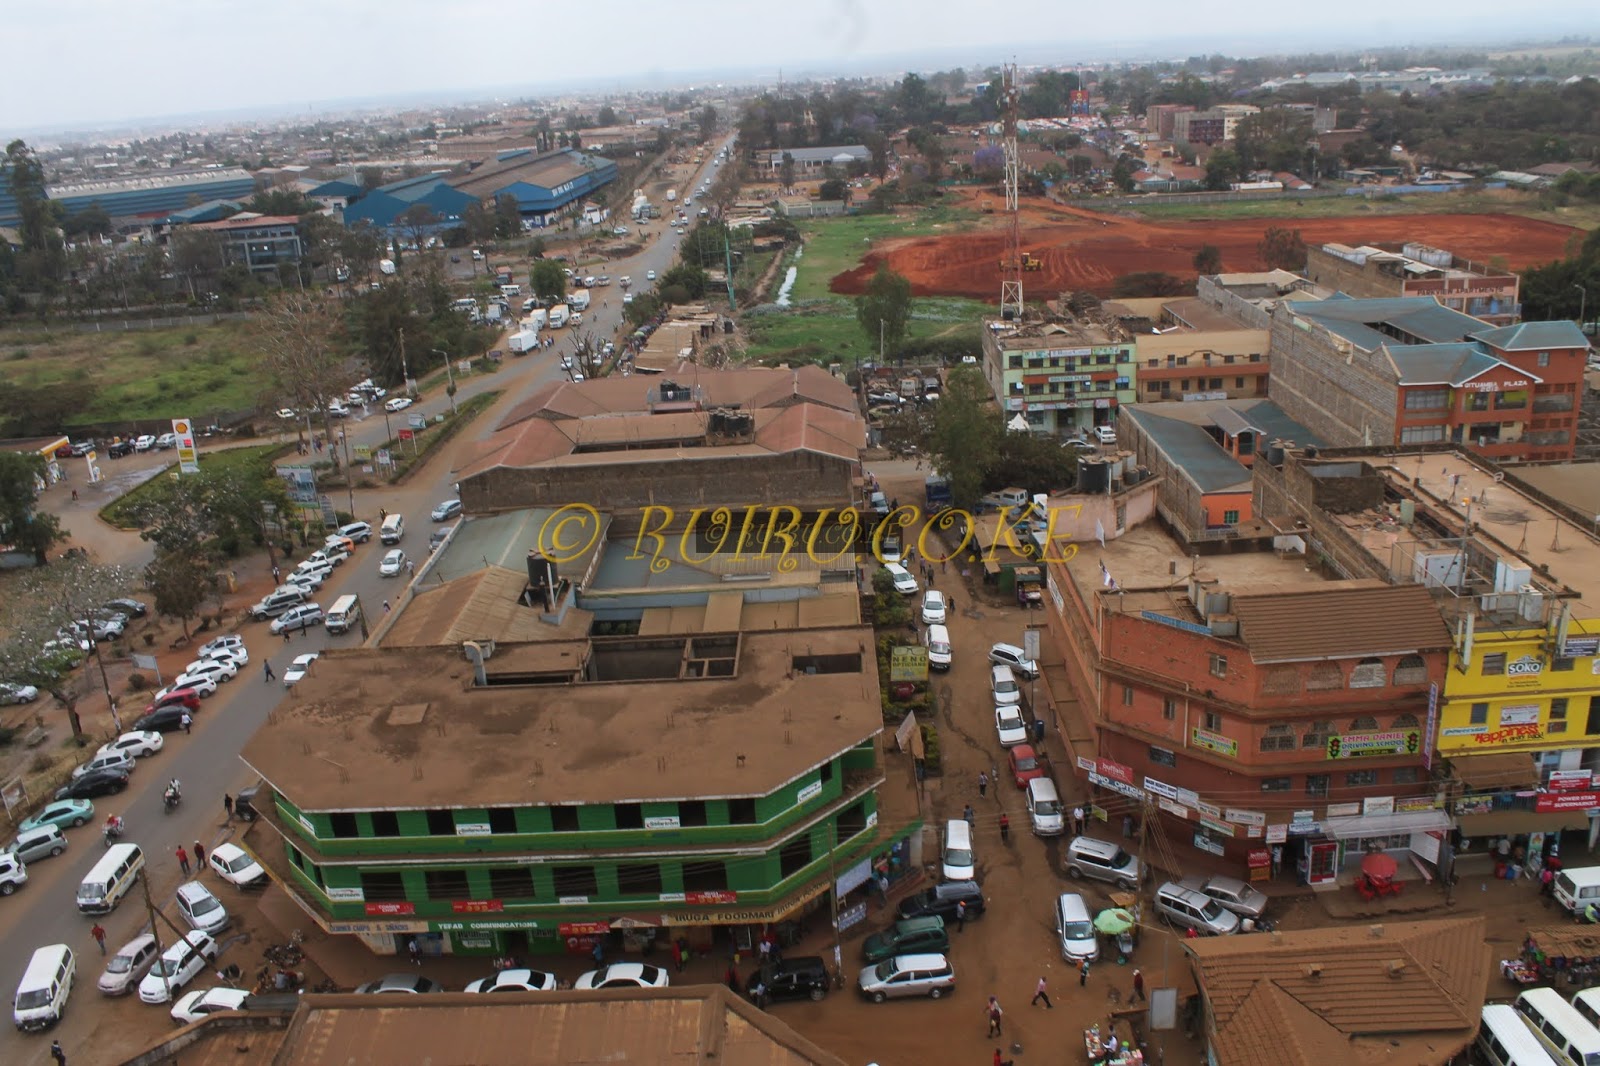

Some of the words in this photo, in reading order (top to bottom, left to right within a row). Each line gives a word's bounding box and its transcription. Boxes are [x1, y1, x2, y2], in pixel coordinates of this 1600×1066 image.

[1504, 380, 1528, 388] PLAZA
[1509, 662, 1541, 673] SOKO
[1342, 735, 1370, 743] EMMA
[1373, 733, 1405, 741] DANIEL
[1341, 742, 1374, 750] DRIVING
[1089, 771, 1109, 783] NENO
[1554, 800, 1598, 808] SUPERMARKET
[470, 921, 538, 930] COMMUNICATIONS
